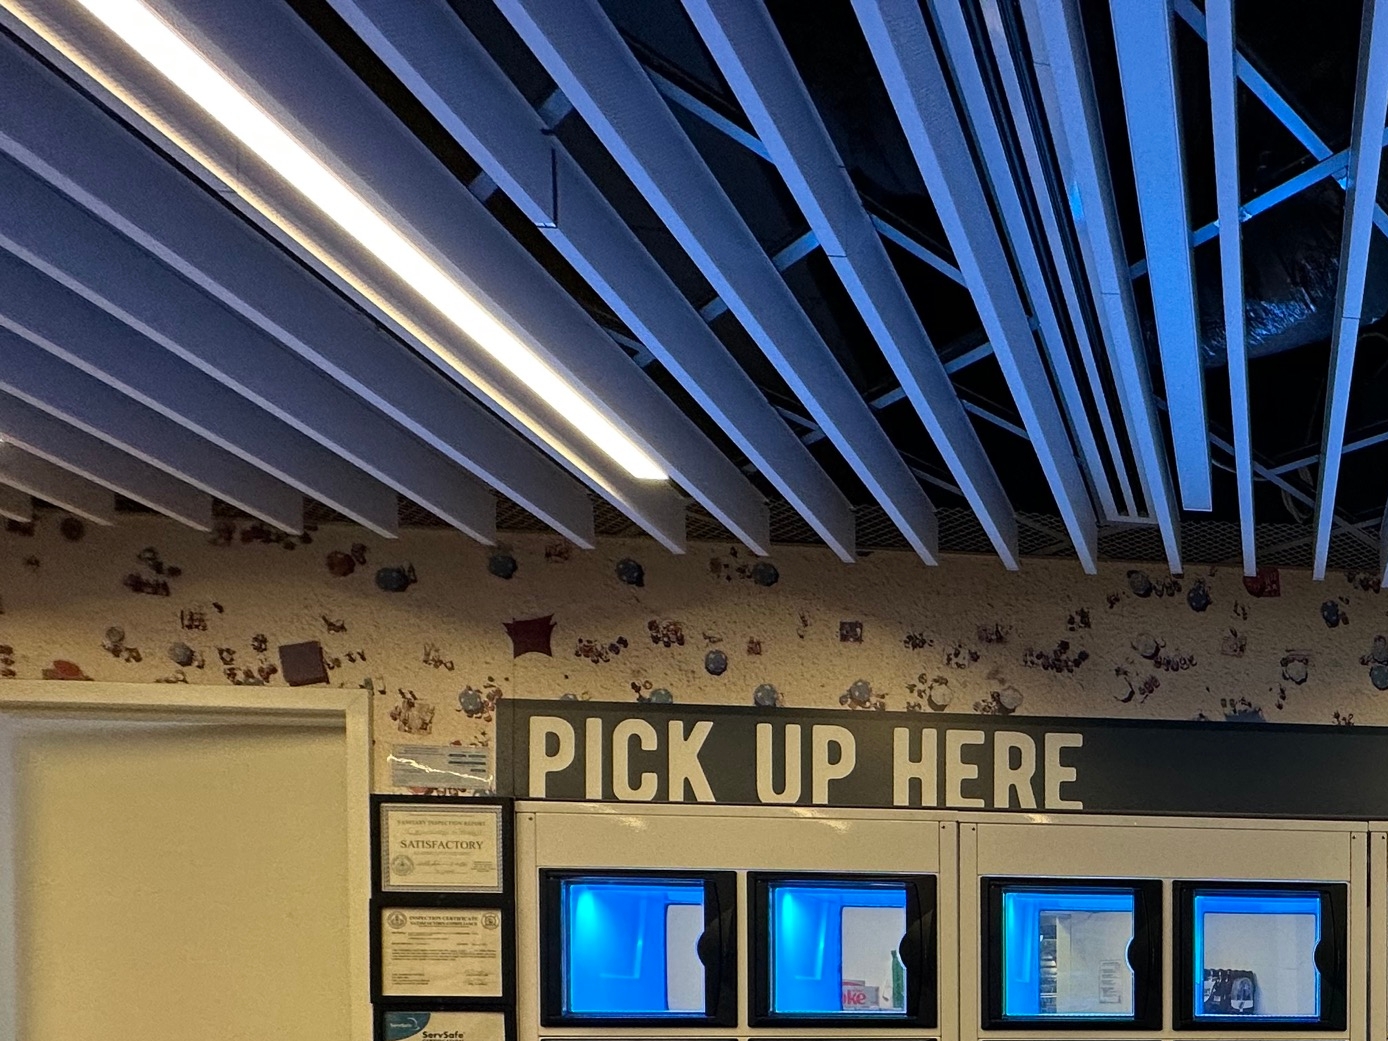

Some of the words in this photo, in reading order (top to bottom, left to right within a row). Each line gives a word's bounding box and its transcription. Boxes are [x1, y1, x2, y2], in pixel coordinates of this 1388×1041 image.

[528, 715, 716, 803] PICK
[756, 722, 857, 805] UP
[892, 727, 1084, 811] HERE
[400, 839, 484, 850] SATISFACTORY
[422, 1031, 464, 1039] ServSafe
